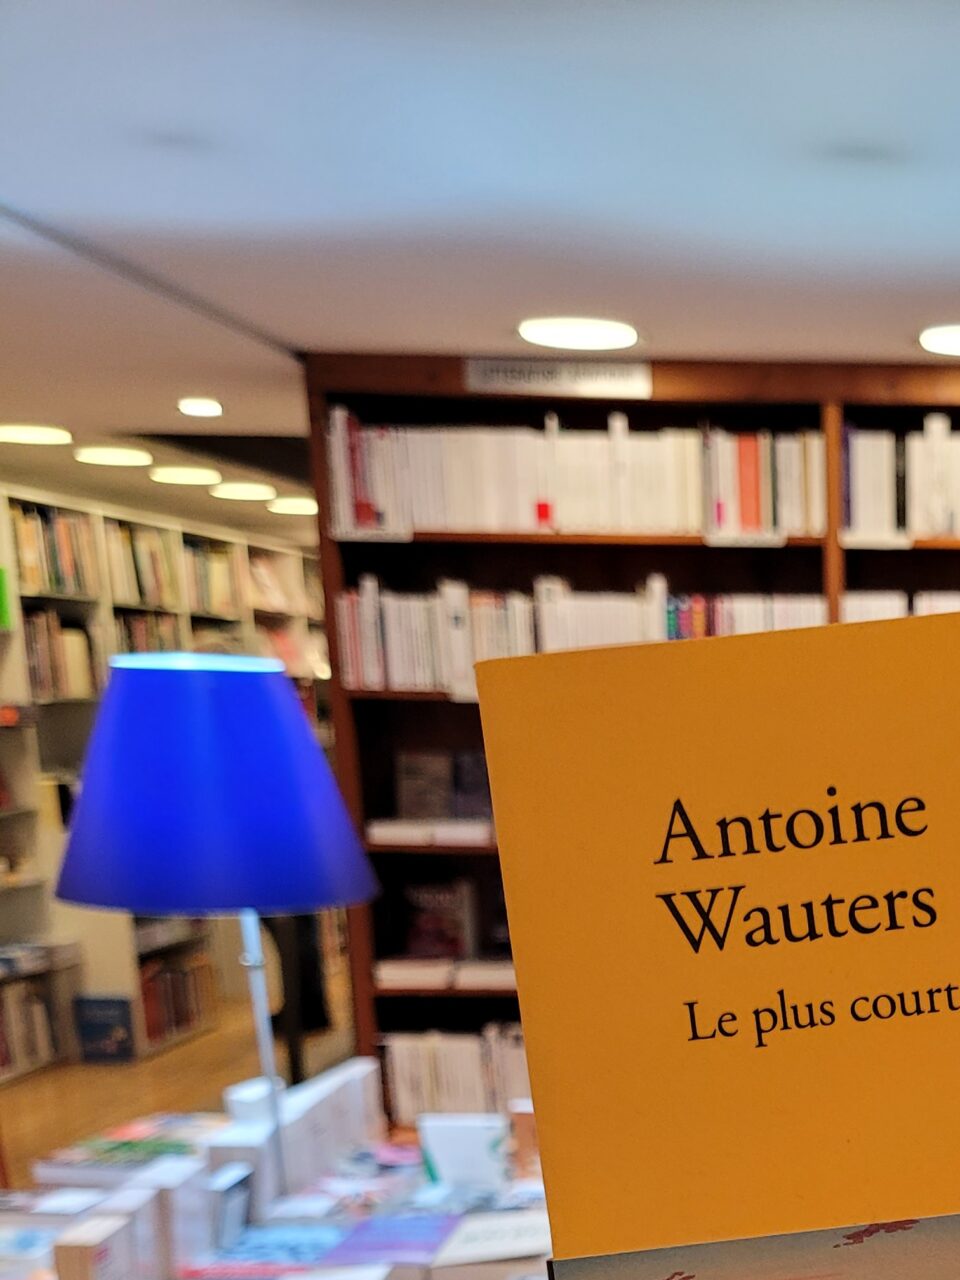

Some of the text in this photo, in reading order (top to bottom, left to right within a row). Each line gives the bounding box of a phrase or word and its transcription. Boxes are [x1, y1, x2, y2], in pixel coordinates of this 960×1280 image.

[653, 785, 929, 865] Antoine
[656, 884, 938, 955] Wauters
[683, 1001, 739, 1042] Le
[754, 989, 836, 1048] plus
[850, 979, 960, 1022] court
